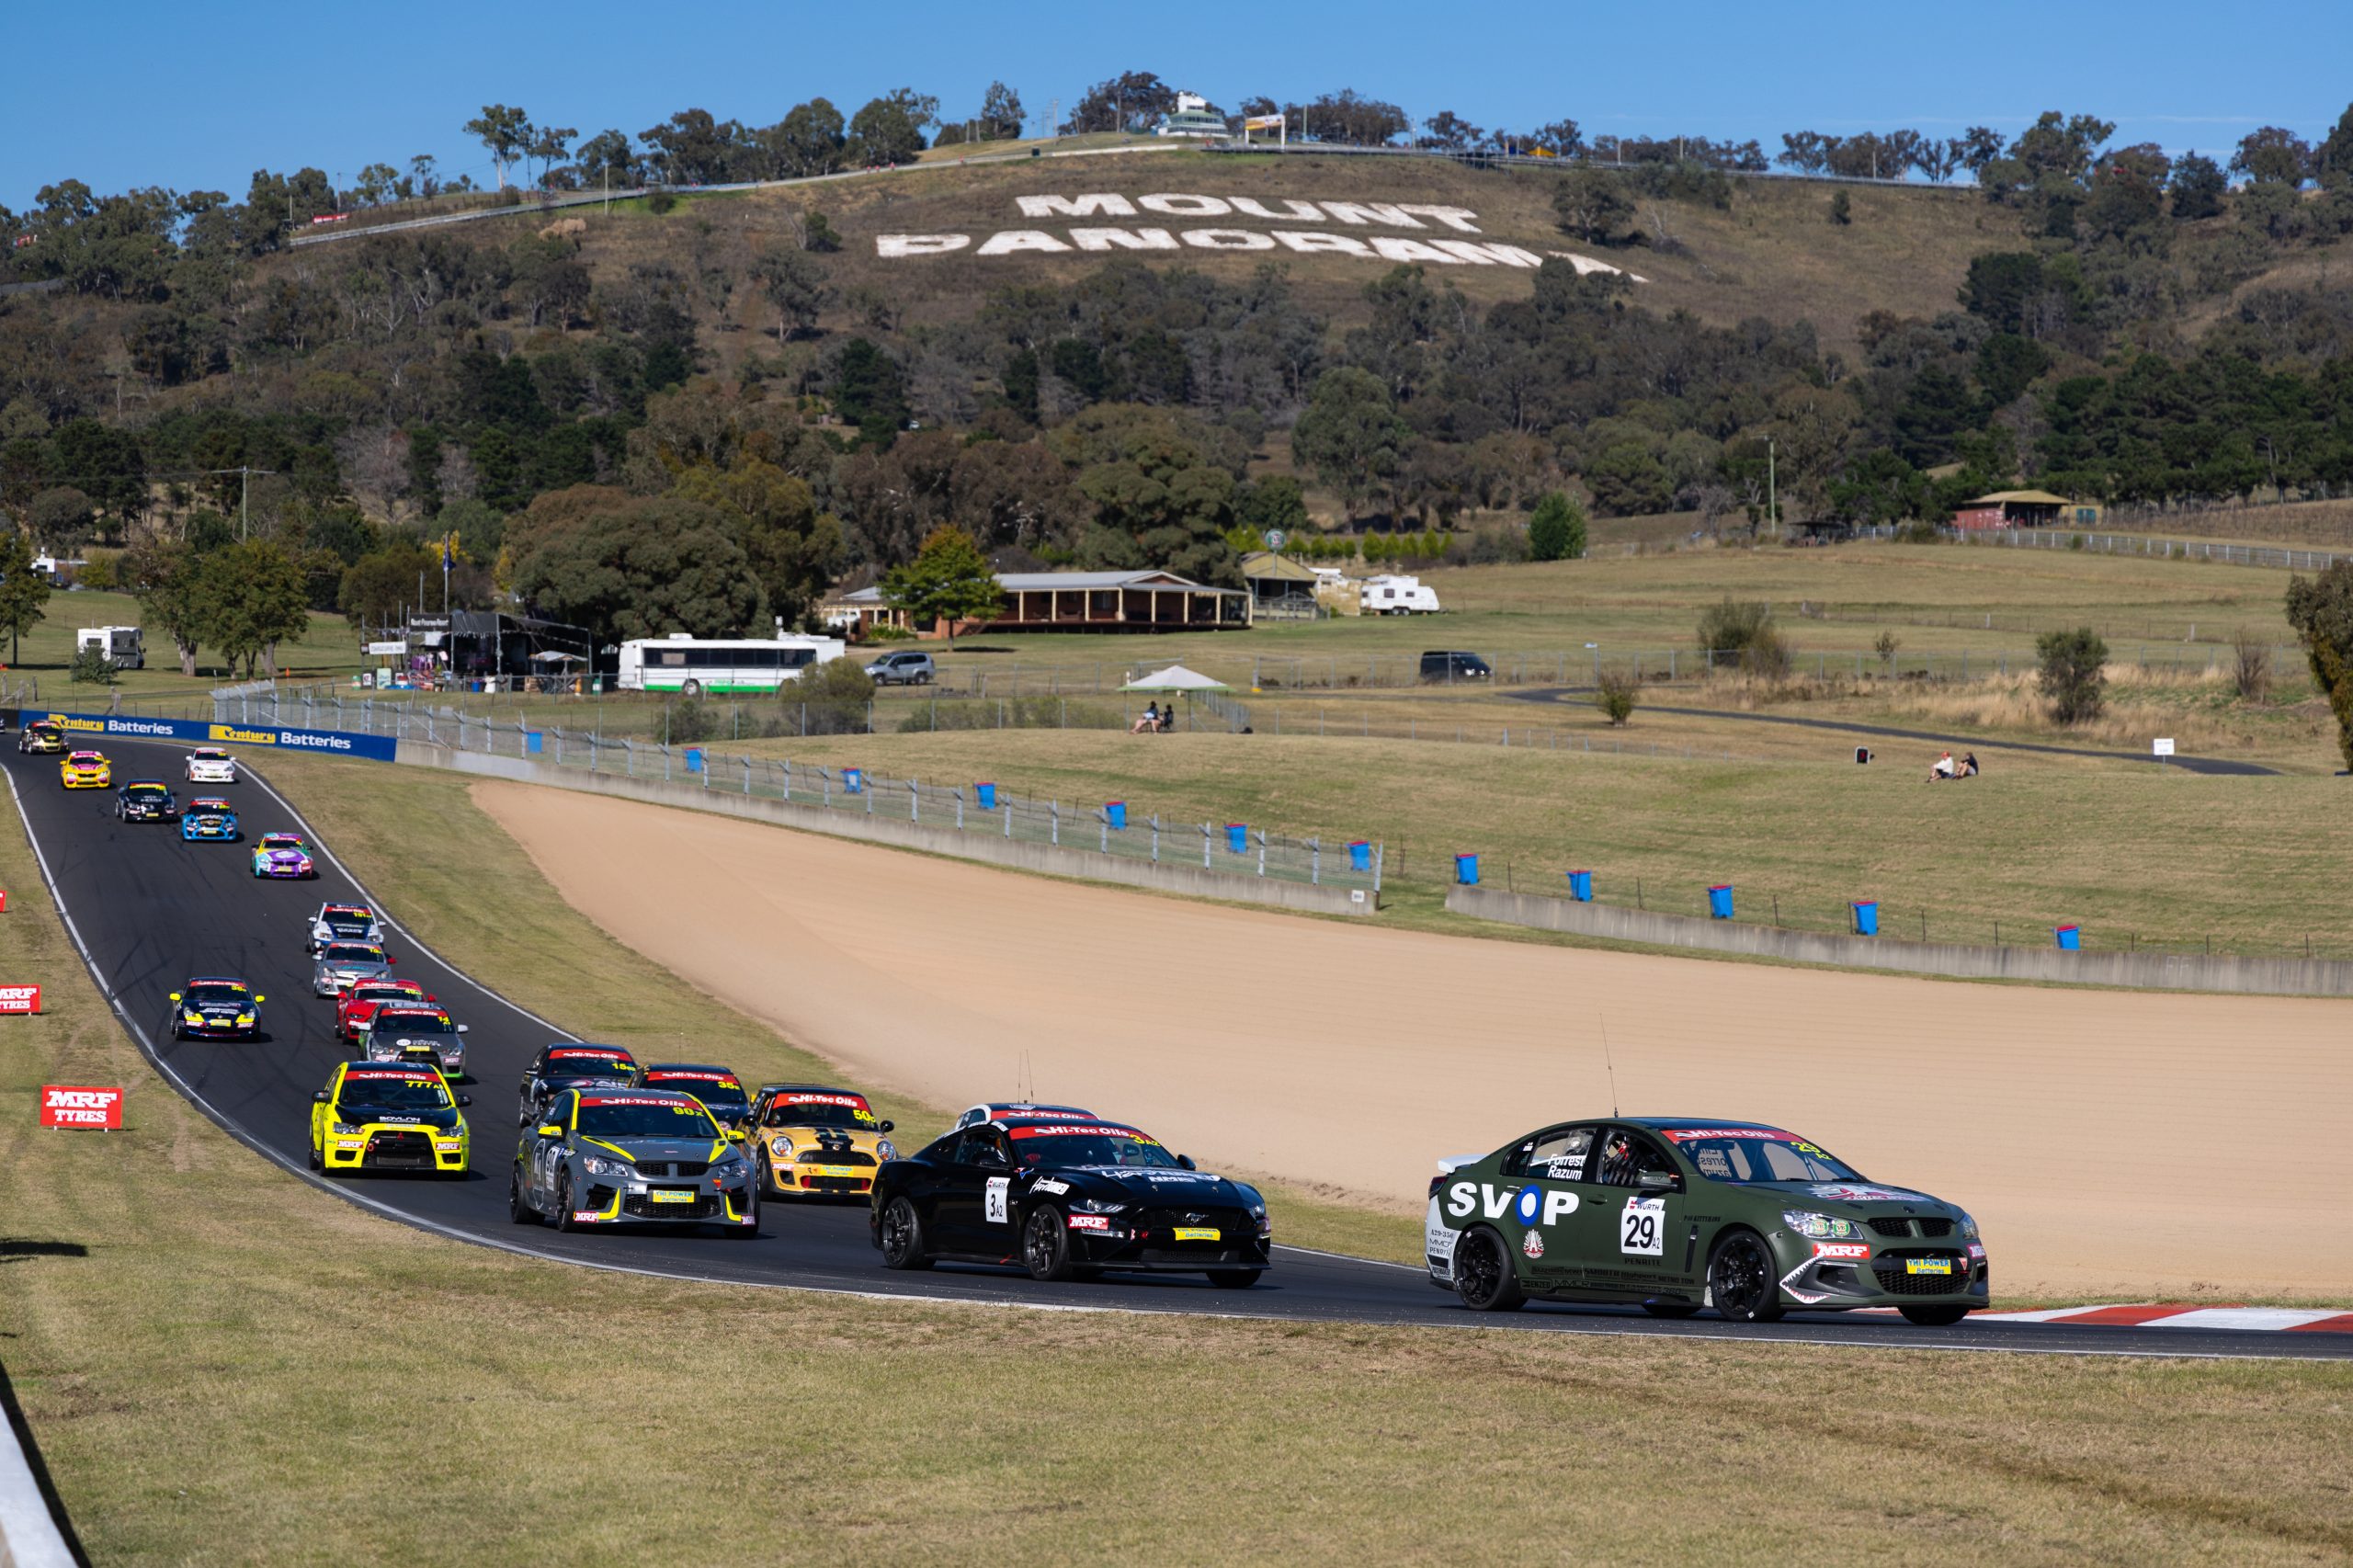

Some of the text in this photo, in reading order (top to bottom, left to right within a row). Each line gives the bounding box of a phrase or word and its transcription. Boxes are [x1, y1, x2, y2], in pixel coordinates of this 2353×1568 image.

[1016, 192, 1481, 233] MOUNT
[877, 227, 1649, 283] PANORAMA
[108, 720, 173, 735] Batteries
[281, 732, 351, 749] Batteries
[703, 1073, 724, 1081] Oils
[46, 1090, 118, 1108] MRF
[613, 1097, 657, 1106] Hi-Tec
[800, 1094, 858, 1108] Hi-Tec Oils
[54, 1109, 108, 1123] TYRES
[1020, 1110, 1060, 1119] Hi-Tec
[1052, 1125, 1130, 1137] Hi-Tec Oils
[1692, 1130, 1776, 1140] Hi-Tec Oils
[1548, 1153, 1586, 1167] Forrest
[1547, 1165, 1583, 1181] Razum
[1069, 1216, 1108, 1228] MRF
[1816, 1244, 1868, 1257] MRF
[1624, 1257, 1662, 1267] PENRITE
[1923, 1258, 1949, 1267] POWER
